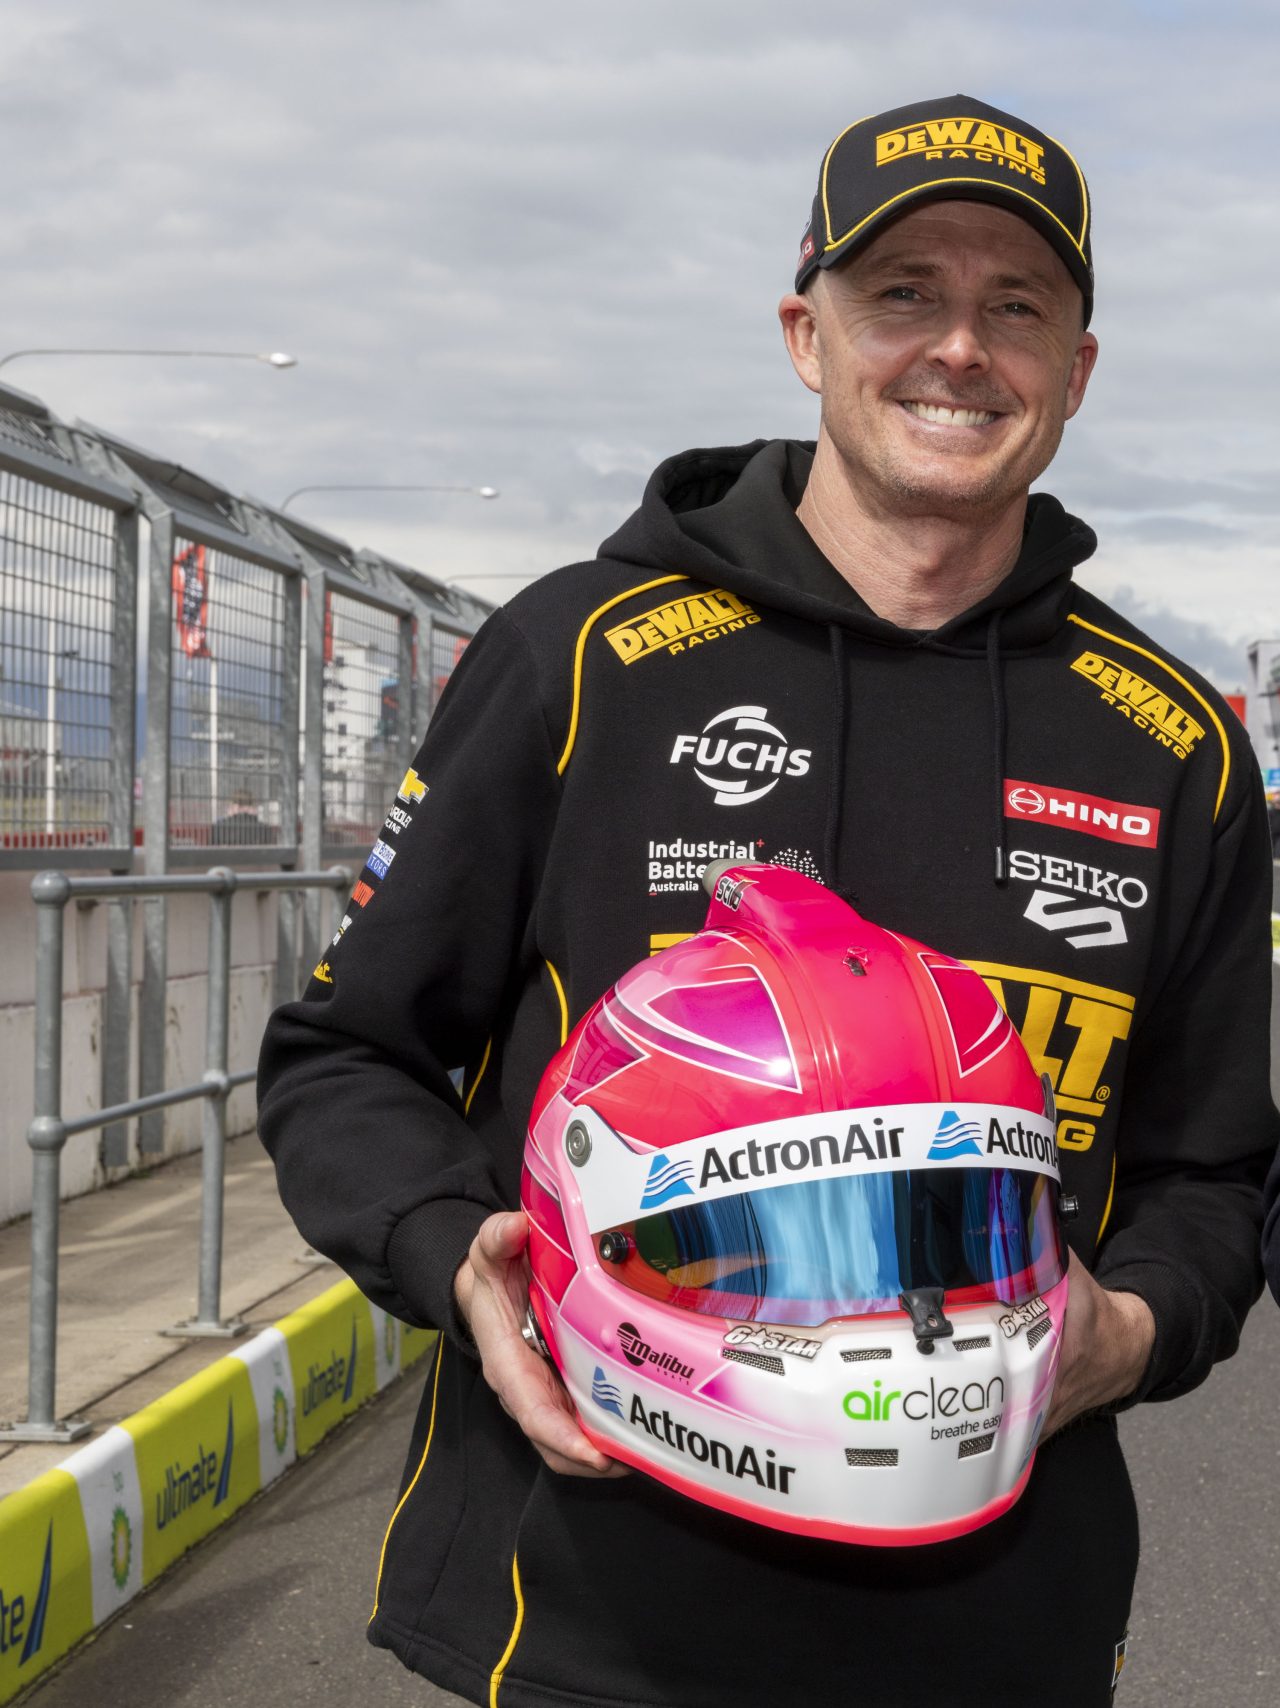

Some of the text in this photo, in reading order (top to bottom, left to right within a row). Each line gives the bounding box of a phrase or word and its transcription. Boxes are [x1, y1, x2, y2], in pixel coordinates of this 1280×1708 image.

[925, 149, 1046, 185] RACING
[668, 614, 762, 656] RACING
[1101, 692, 1187, 760] RACING
[669, 735, 812, 777] FUCHS
[1050, 799, 1150, 836] HINO
[649, 838, 755, 861] Industrial
[649, 881, 699, 893] Australia
[1009, 850, 1148, 909] SEIKO
[699, 1118, 905, 1188] ActronAir
[302, 1350, 345, 1417] ultimate
[630, 1394, 796, 1495] ActronAir
[931, 1417, 980, 1441] breathe
[155, 1443, 218, 1532] ultimate
